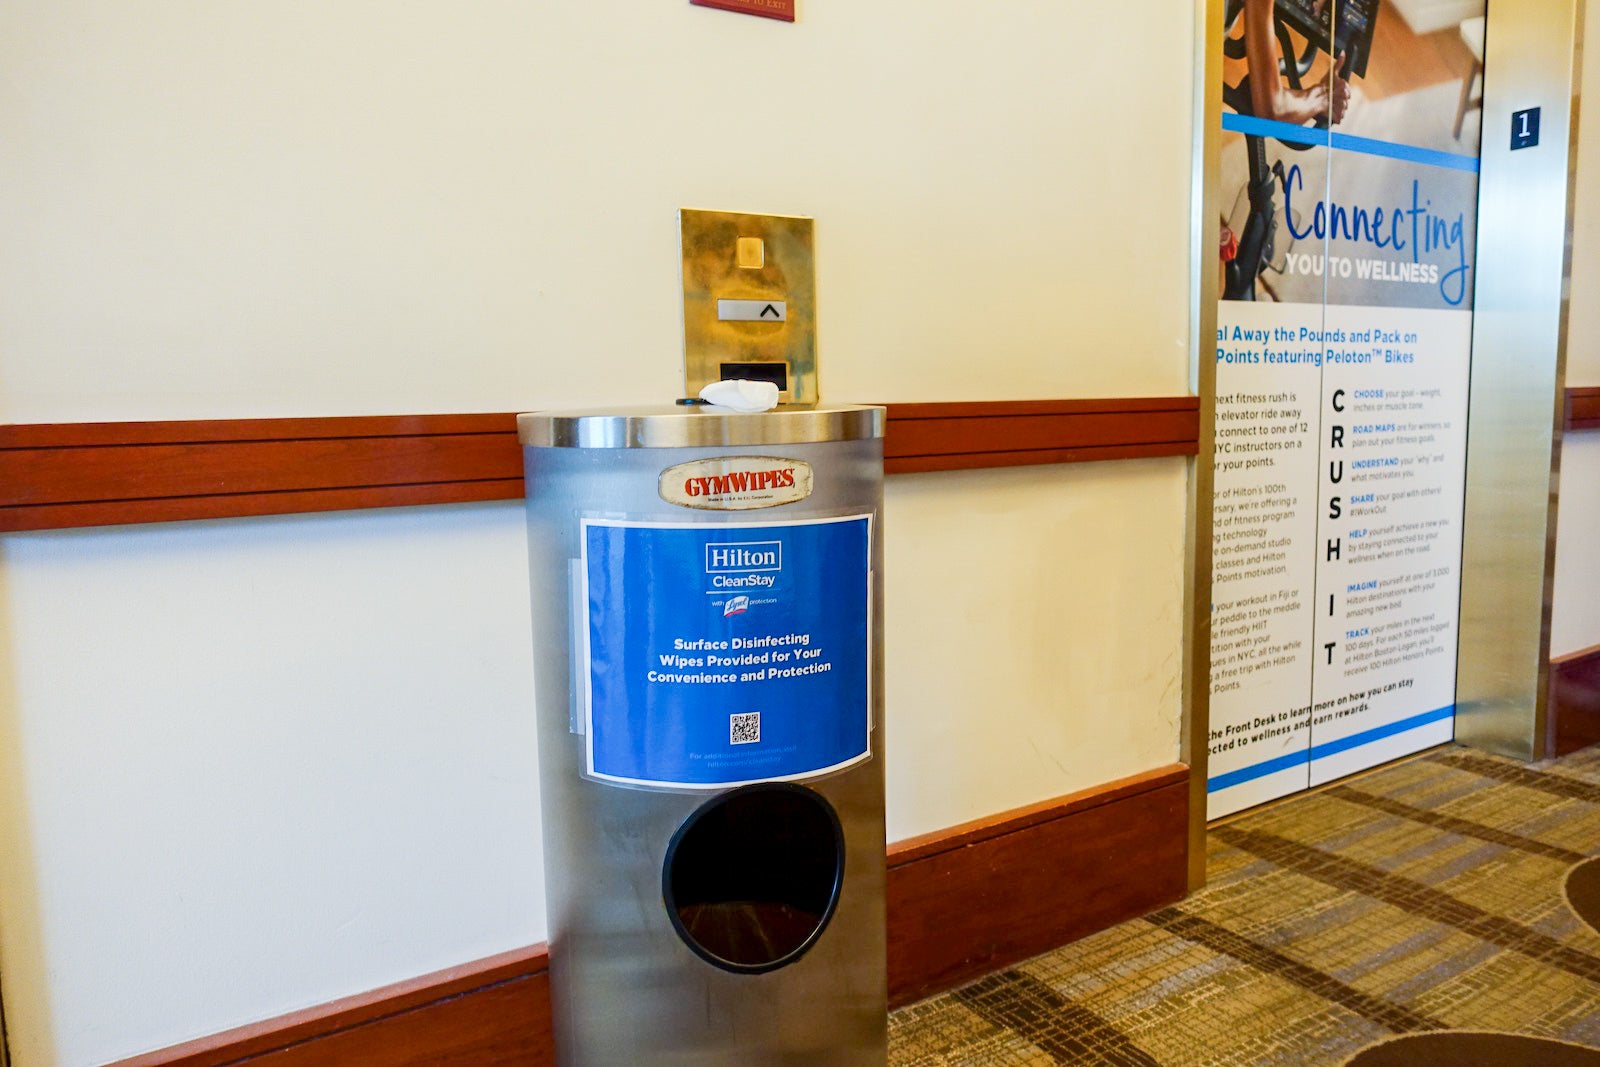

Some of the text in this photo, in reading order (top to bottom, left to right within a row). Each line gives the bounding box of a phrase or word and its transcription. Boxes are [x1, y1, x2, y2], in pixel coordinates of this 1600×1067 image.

[766, 0, 786, 9] EXIT
[1518, 112, 1531, 138] 1
[1284, 164, 1470, 305] Connecting
[1285, 253, 1439, 285] YOU TO WELLNESS
[1216, 325, 1417, 345] al Away the Pounds and Pack on
[1216, 348, 1260, 364] Points
[1263, 348, 1322, 367] featuring
[1384, 349, 1415, 363] Bikes
[1236, 392, 1267, 404] fitness
[1268, 392, 1288, 403] rush
[1289, 391, 1297, 402] is
[1332, 389, 1345, 412] C
[1353, 389, 1384, 399] CHOOSE
[1221, 410, 1259, 421] elevator
[1261, 409, 1278, 419] ride
[1280, 409, 1302, 419] away
[1220, 422, 1309, 437] connect to one of 12
[1331, 425, 1344, 448] R
[1352, 423, 1396, 434] ROAD MAPS
[1233, 440, 1302, 453] instructors on a
[1223, 461, 1244, 472] your
[1330, 460, 1343, 484] U
[1351, 457, 1399, 469] UNDERSTAND
[684, 468, 796, 497] GYMWIPES
[1222, 488, 1231, 498] of
[1233, 487, 1263, 497] Hilton's
[1264, 484, 1287, 494] 100th
[1260, 497, 1291, 508] offering
[1329, 496, 1341, 520] S
[1350, 493, 1375, 505] SHARE
[1223, 516, 1232, 526] of
[1234, 514, 1261, 525] fitness
[1262, 511, 1295, 523] program
[1223, 528, 1267, 541] technology
[1349, 528, 1368, 539] HELP
[1220, 541, 1266, 555] on-demand
[1268, 538, 1292, 548] studio
[1327, 538, 1340, 562] H
[712, 548, 776, 567] Hilton
[1215, 552, 1286, 570] classes and Hilton
[712, 574, 776, 588] CleanStay
[1216, 572, 1242, 583] Points
[1346, 580, 1378, 593] IMAGINE
[749, 598, 777, 606] protection
[1216, 602, 1234, 614] your
[1235, 594, 1268, 608] workout
[1269, 593, 1277, 601] in
[1278, 590, 1290, 601] Fiji
[1291, 589, 1299, 597] or
[1329, 594, 1334, 616] I
[1220, 612, 1247, 626] peddle
[1249, 611, 1258, 619] to
[1259, 607, 1272, 617] the
[1273, 601, 1301, 614] meddle
[1220, 625, 1250, 638] friendly
[1345, 627, 1370, 639] TRACK
[674, 633, 810, 651] Surface Disinfecting
[1211, 634, 1271, 654] tition with your
[659, 647, 822, 669] Wipes Provided for Your
[1211, 658, 1227, 668] ues
[1228, 655, 1236, 664] in
[1258, 647, 1267, 657] all
[1268, 645, 1281, 655] the
[1282, 640, 1302, 651] while
[1324, 642, 1336, 665] T
[647, 661, 832, 684] Convenience and Protection
[1221, 667, 1238, 678] free
[1239, 663, 1254, 674] trip
[1255, 660, 1272, 671] with
[1273, 654, 1296, 666] Hilton
[1225, 721, 1251, 736] Front
[1254, 714, 1276, 728] Desk
[1278, 711, 1288, 721] to
[1290, 705, 1312, 718] learn
[1314, 700, 1336, 711] more
[1337, 696, 1348, 705] on
[1349, 692, 1365, 702] how
[1367, 687, 1382, 699] you
[1383, 683, 1397, 692] can
[1398, 678, 1415, 688] stay
[1208, 739, 1235, 756] ected
[1238, 737, 1248, 747] to
[1251, 725, 1291, 743] wellness
[1293, 717, 1312, 731] and
[1313, 713, 1333, 725] earn
